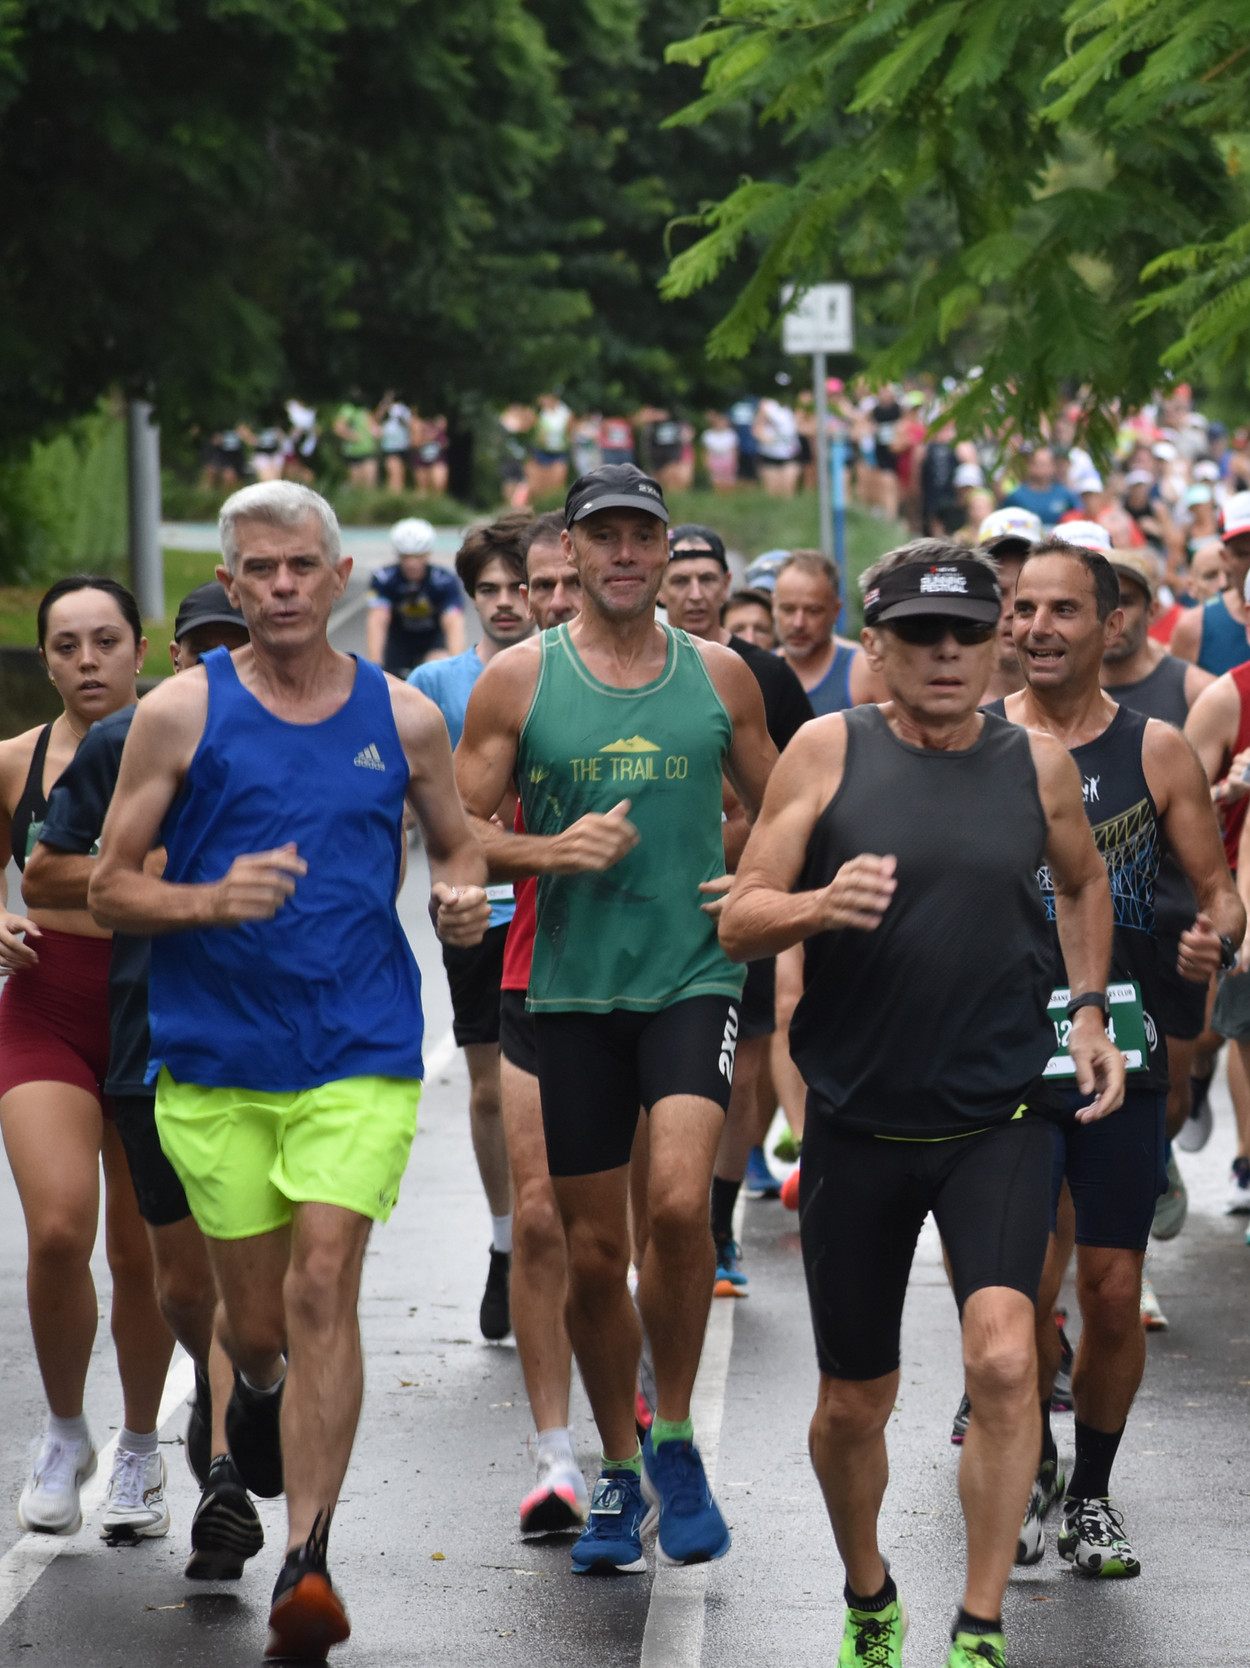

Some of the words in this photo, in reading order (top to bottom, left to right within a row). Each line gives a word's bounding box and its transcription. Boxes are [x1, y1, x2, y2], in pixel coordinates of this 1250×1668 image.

[569, 757, 603, 782] THE
[610, 757, 659, 782] TRAIL
[665, 755, 688, 779] CO
[718, 1005, 738, 1086] 2XU
